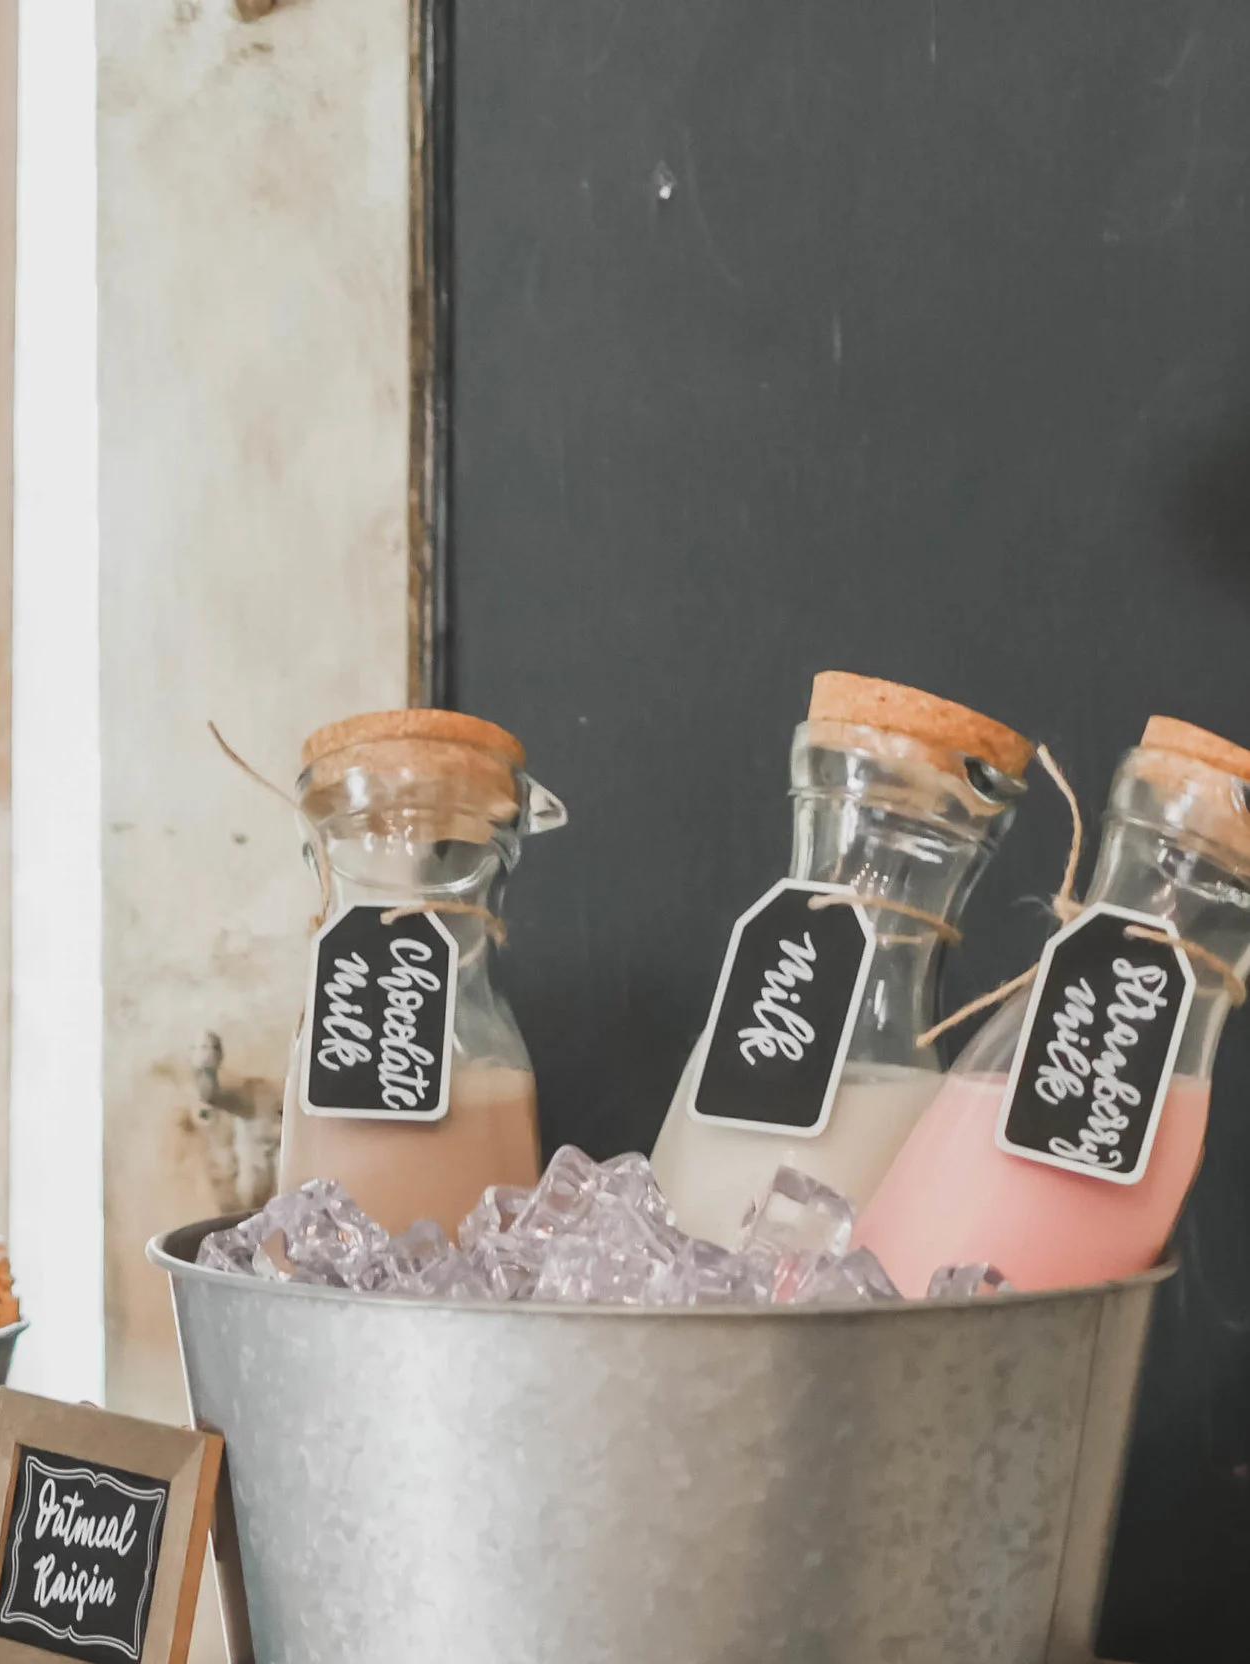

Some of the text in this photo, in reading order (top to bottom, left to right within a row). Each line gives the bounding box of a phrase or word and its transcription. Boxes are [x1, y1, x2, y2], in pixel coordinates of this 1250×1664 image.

[317, 952, 372, 1072] milk
[377, 938, 441, 1110] Chocolate
[737, 931, 817, 1066] milk
[1034, 977, 1096, 1105] milk
[1048, 957, 1168, 1169] Strawberry
[35, 1478, 137, 1556] Oatmeal
[34, 1553, 116, 1621] Raisin
